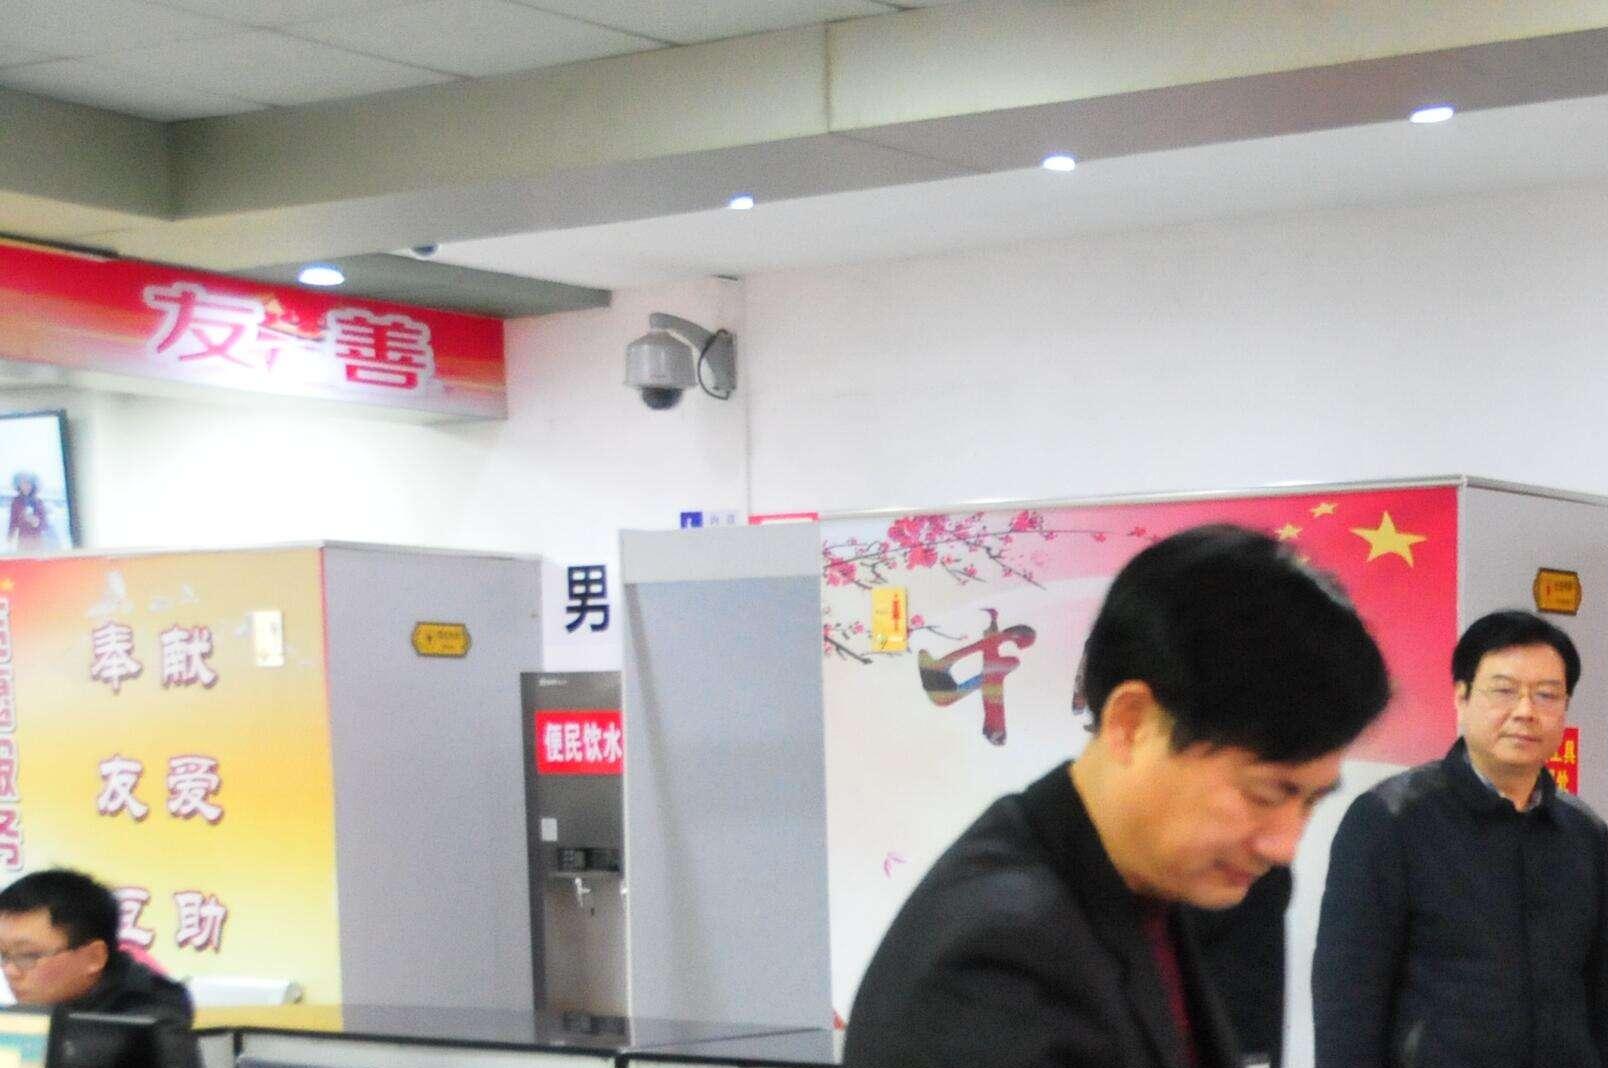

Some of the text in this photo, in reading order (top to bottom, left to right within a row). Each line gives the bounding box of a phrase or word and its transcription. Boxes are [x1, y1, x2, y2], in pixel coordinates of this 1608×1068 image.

[565, 564, 611, 634] 男
[90, 619, 219, 694] 奉献
[98, 754, 225, 826] 友爱
